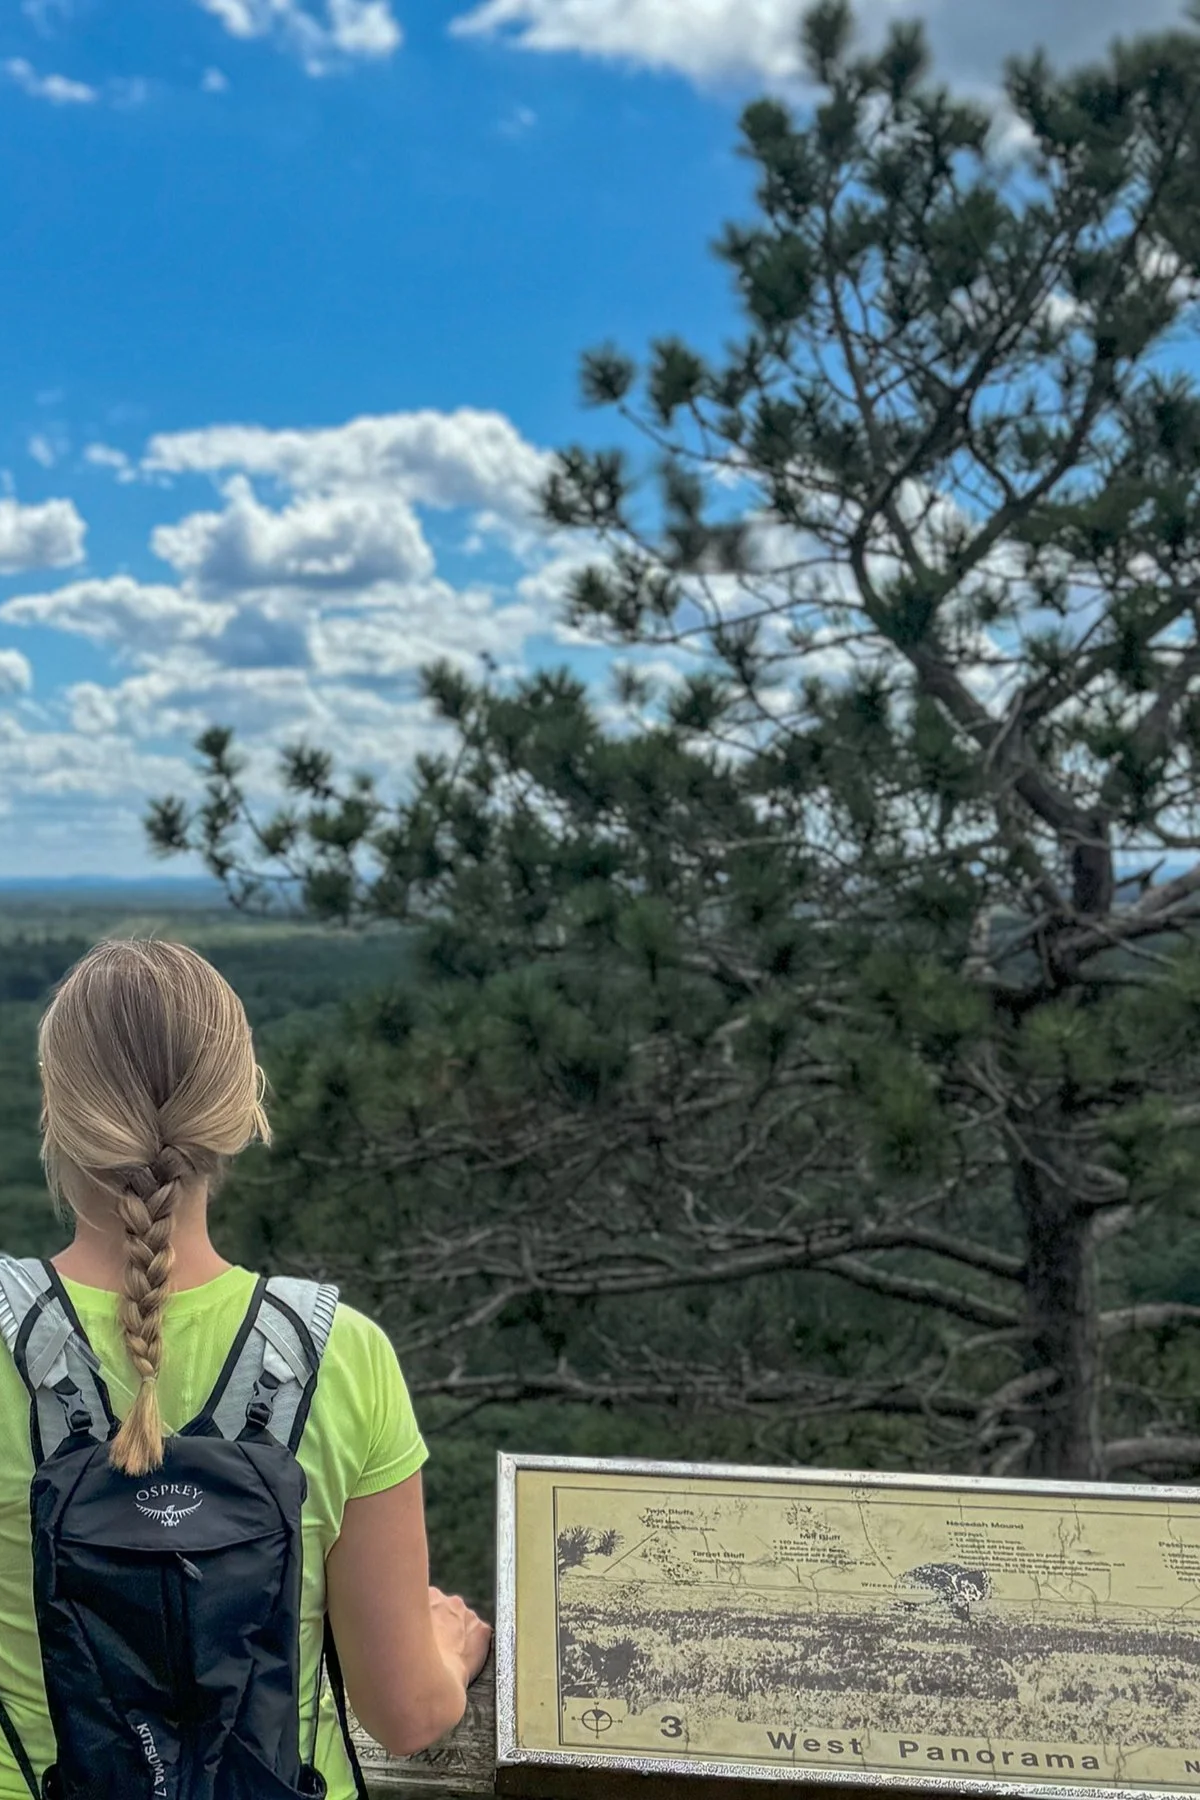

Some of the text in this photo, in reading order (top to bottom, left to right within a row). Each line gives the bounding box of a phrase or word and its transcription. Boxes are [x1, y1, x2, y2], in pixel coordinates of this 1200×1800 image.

[136, 1484, 203, 1501] OSPREY
[991, 1521, 1024, 1530] Mound
[137, 1723, 167, 1797] KITSUMA 7
[660, 1715, 683, 1738] 3
[767, 1731, 863, 1755] West
[899, 1740, 1100, 1770] Panorama
